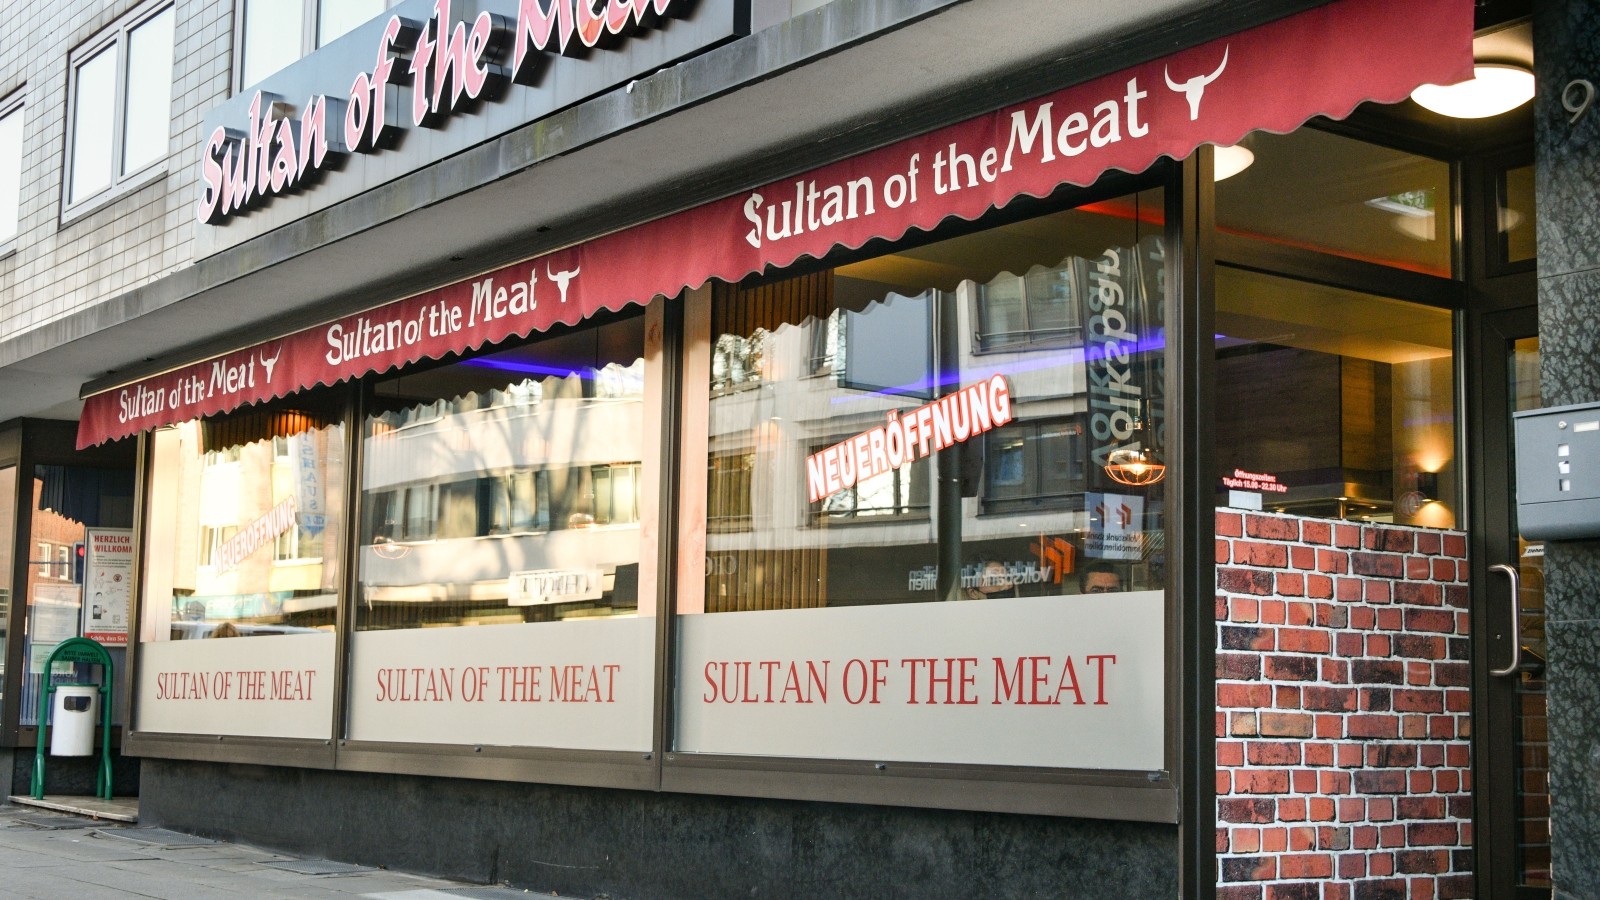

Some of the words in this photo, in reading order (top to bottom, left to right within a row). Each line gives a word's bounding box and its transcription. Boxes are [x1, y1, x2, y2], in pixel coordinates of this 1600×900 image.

[197, 89, 328, 224] Sultan
[345, 14, 401, 152] of
[408, 0, 492, 126] the
[1561, 79, 1595, 123] 9
[743, 179, 875, 249] Sultan
[883, 152, 920, 210] of
[932, 142, 998, 196] the
[1000, 76, 1149, 173] Meat
[325, 317, 402, 366] Sultan
[404, 305, 427, 345] of
[428, 300, 462, 338] the
[468, 267, 538, 328] Meat
[118, 384, 165, 424] Sultan
[168, 378, 183, 410] of
[184, 375, 205, 404] the
[207, 354, 255, 398] Meat
[805, 374, 1013, 504] NEUERÖFFNUNG
[1276, 484, 1288, 493] Uhr
[94, 535, 130, 544] HERZLICH
[156, 671, 210, 700] SULTAN
[213, 671, 232, 700] OF
[236, 671, 266, 700] THE
[270, 670, 316, 700] MEAT
[376, 668, 454, 702] SULTAN
[461, 666, 489, 702] OF
[497, 666, 542, 702] THE
[548, 664, 620, 702] MEAT
[703, 660, 830, 704] SULTAN
[842, 659, 889, 705] OF
[901, 657, 979, 705] THE
[991, 654, 1117, 705] MEAT
